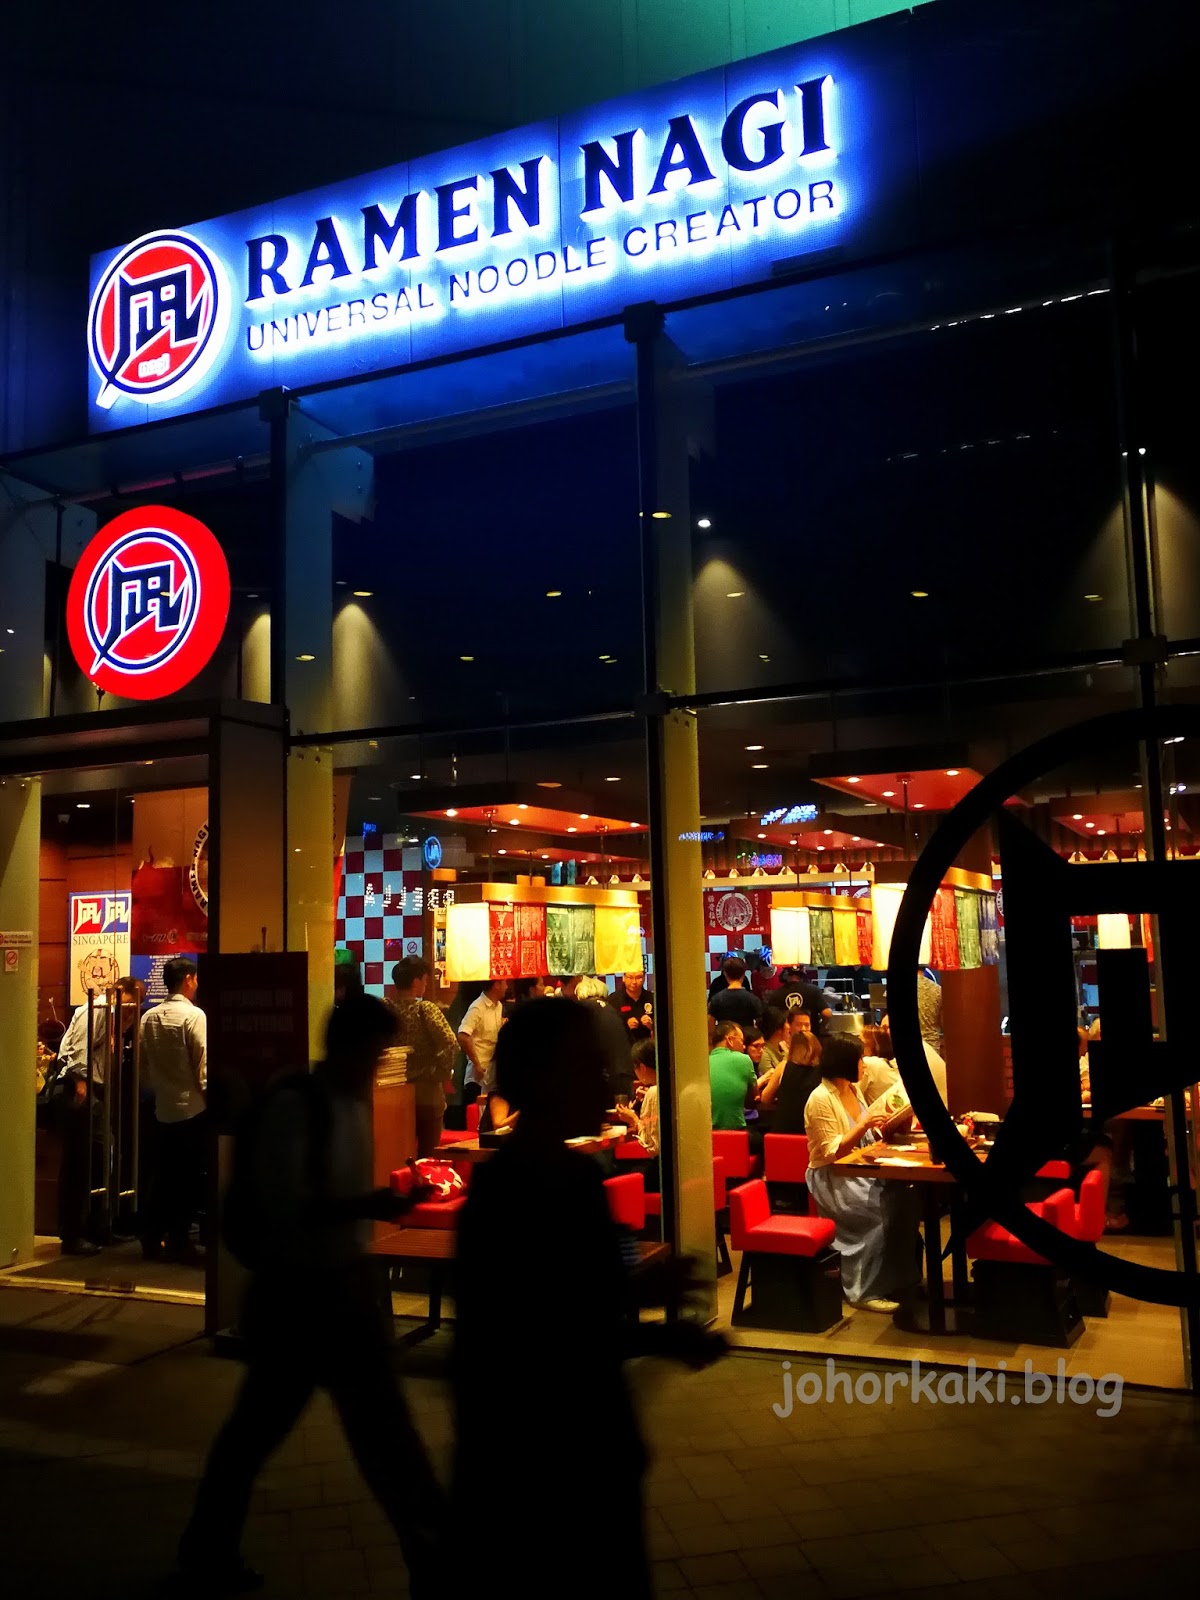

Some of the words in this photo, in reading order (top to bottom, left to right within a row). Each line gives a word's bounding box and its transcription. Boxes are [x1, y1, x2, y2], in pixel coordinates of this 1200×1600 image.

[245, 155, 547, 302] RAMEN
[580, 74, 833, 213] NAGI
[248, 281, 435, 350] UNIVERSAL
[450, 236, 606, 303] NOODLE
[623, 180, 834, 256] CREATOR
[72, 934, 129, 945] SINGAPORE
